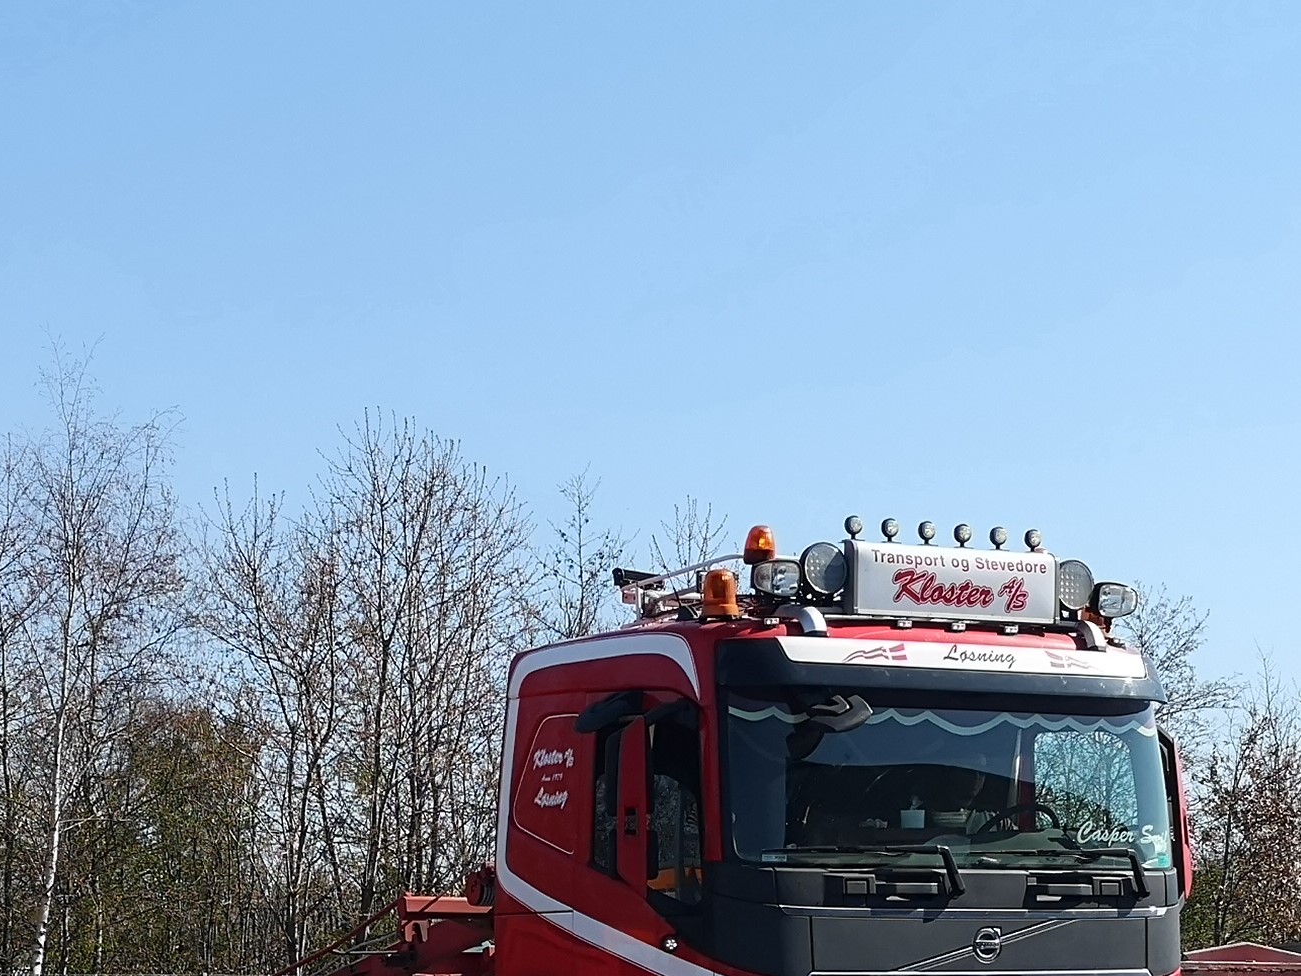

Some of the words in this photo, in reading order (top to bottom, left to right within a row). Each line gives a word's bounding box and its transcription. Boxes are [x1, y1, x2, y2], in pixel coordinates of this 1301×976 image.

[871, 549, 946, 569] Transport
[951, 557, 970, 572] og
[975, 557, 1048, 574] Stevedore
[892, 568, 994, 608] Kloster
[998, 576, 1029, 614] A/S
[943, 644, 1017, 669] Løsning
[1077, 821, 1136, 848] Casper
